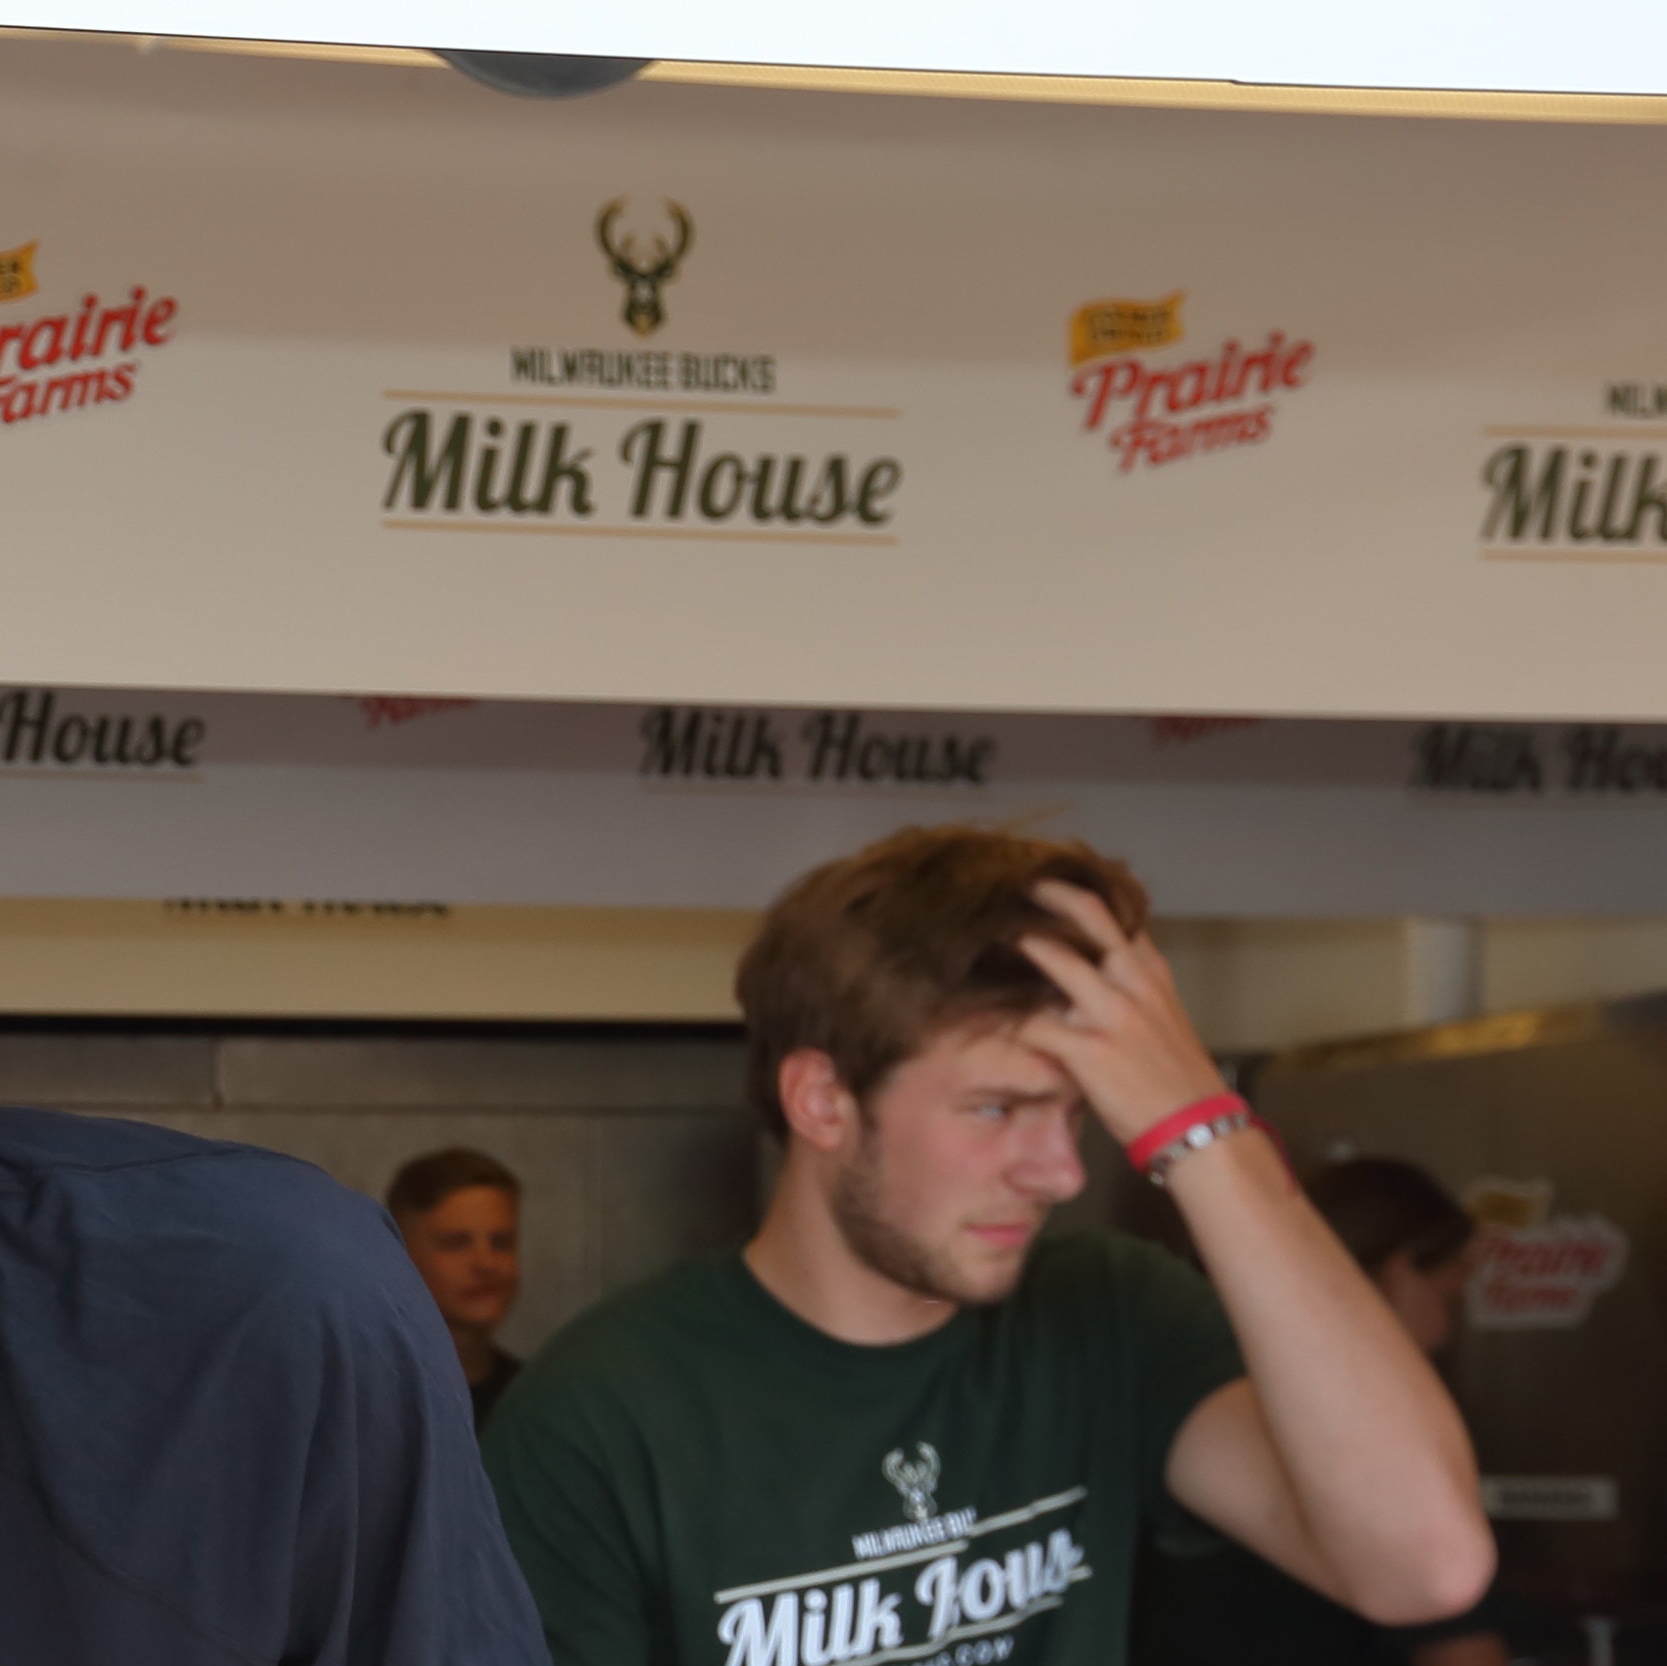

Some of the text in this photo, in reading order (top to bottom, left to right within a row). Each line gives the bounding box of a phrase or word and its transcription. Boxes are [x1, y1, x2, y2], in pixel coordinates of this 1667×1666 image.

[509, 347, 777, 394] MILWAUKEE BUCKS
[1071, 329, 1315, 431] Prairie
[381, 407, 905, 530] Milk House
[638, 707, 996, 786] Milk House
